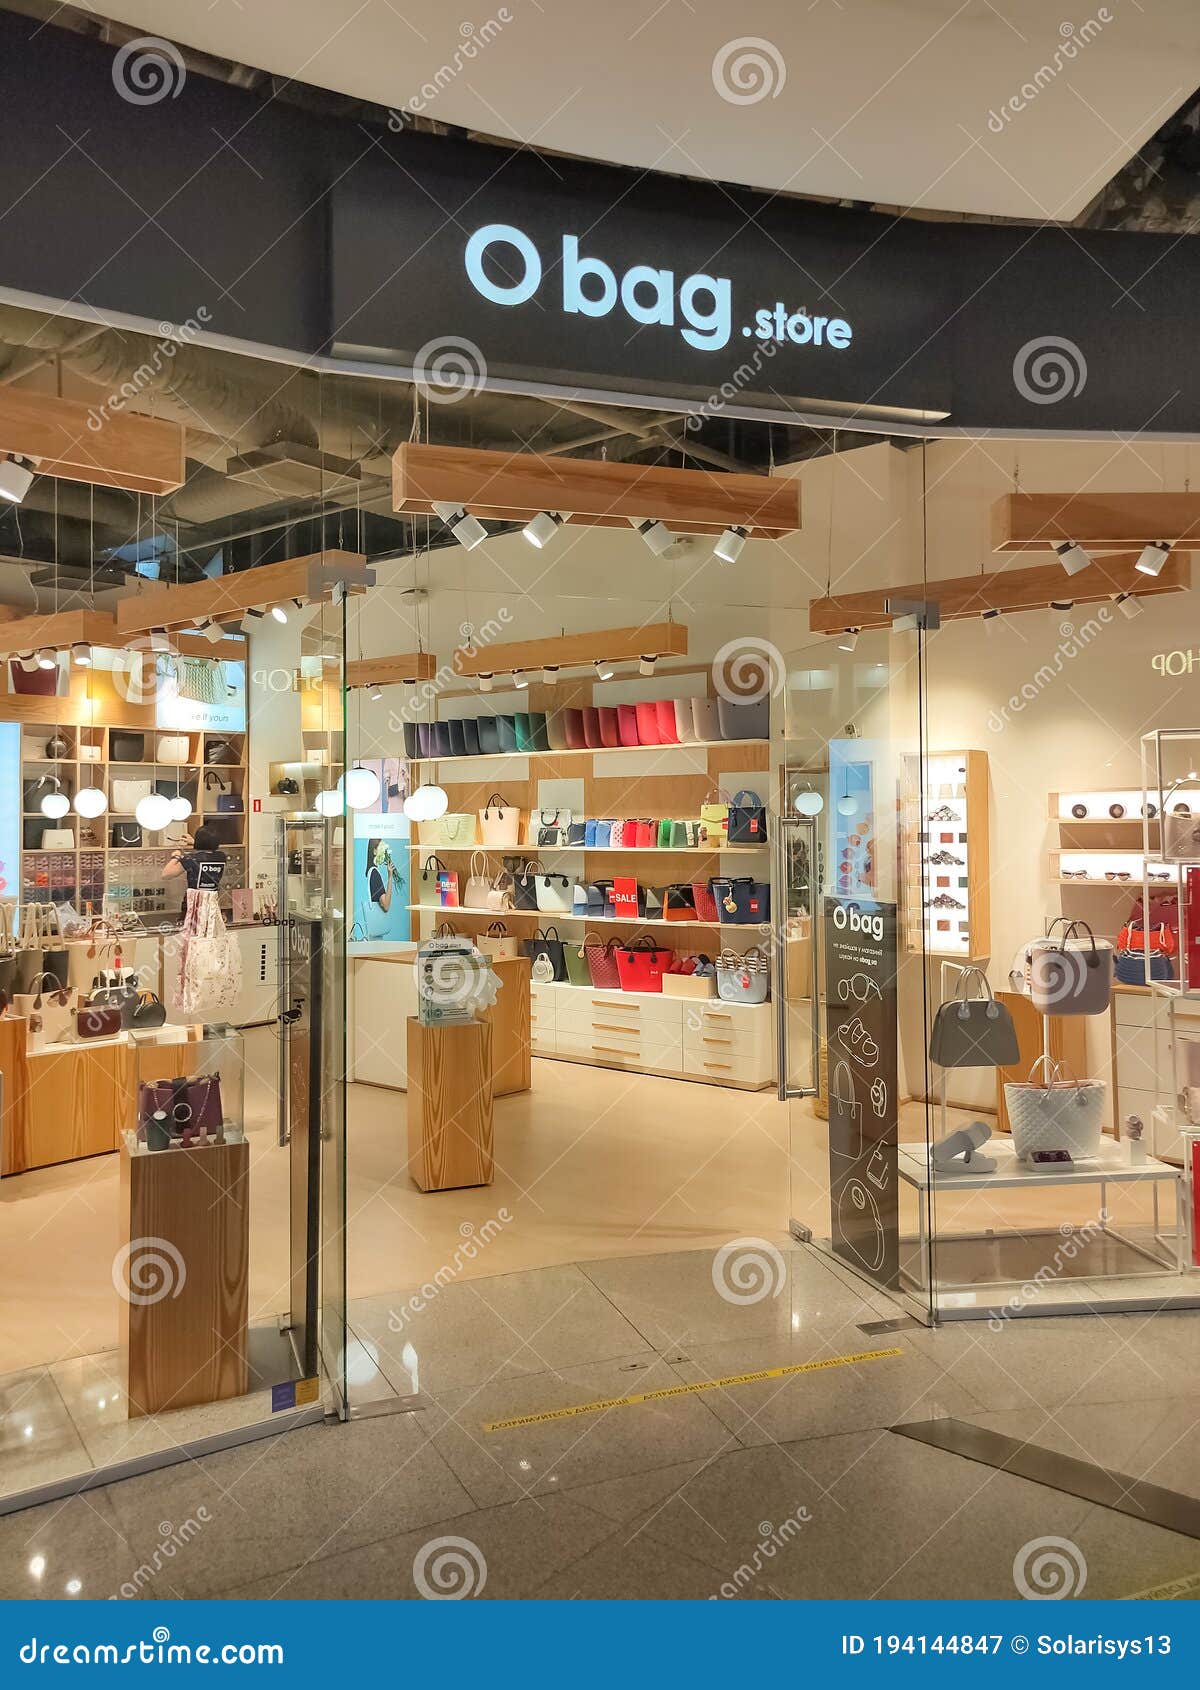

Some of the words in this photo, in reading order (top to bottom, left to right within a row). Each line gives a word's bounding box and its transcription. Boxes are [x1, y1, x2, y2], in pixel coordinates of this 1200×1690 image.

[465, 223, 542, 305] O
[562, 234, 732, 351] bag
[742, 302, 853, 349] .store
[441, 881, 457, 889] new
[615, 893, 637, 903] SALE
[833, 905, 847, 930] O
[850, 907, 884, 941] bag
